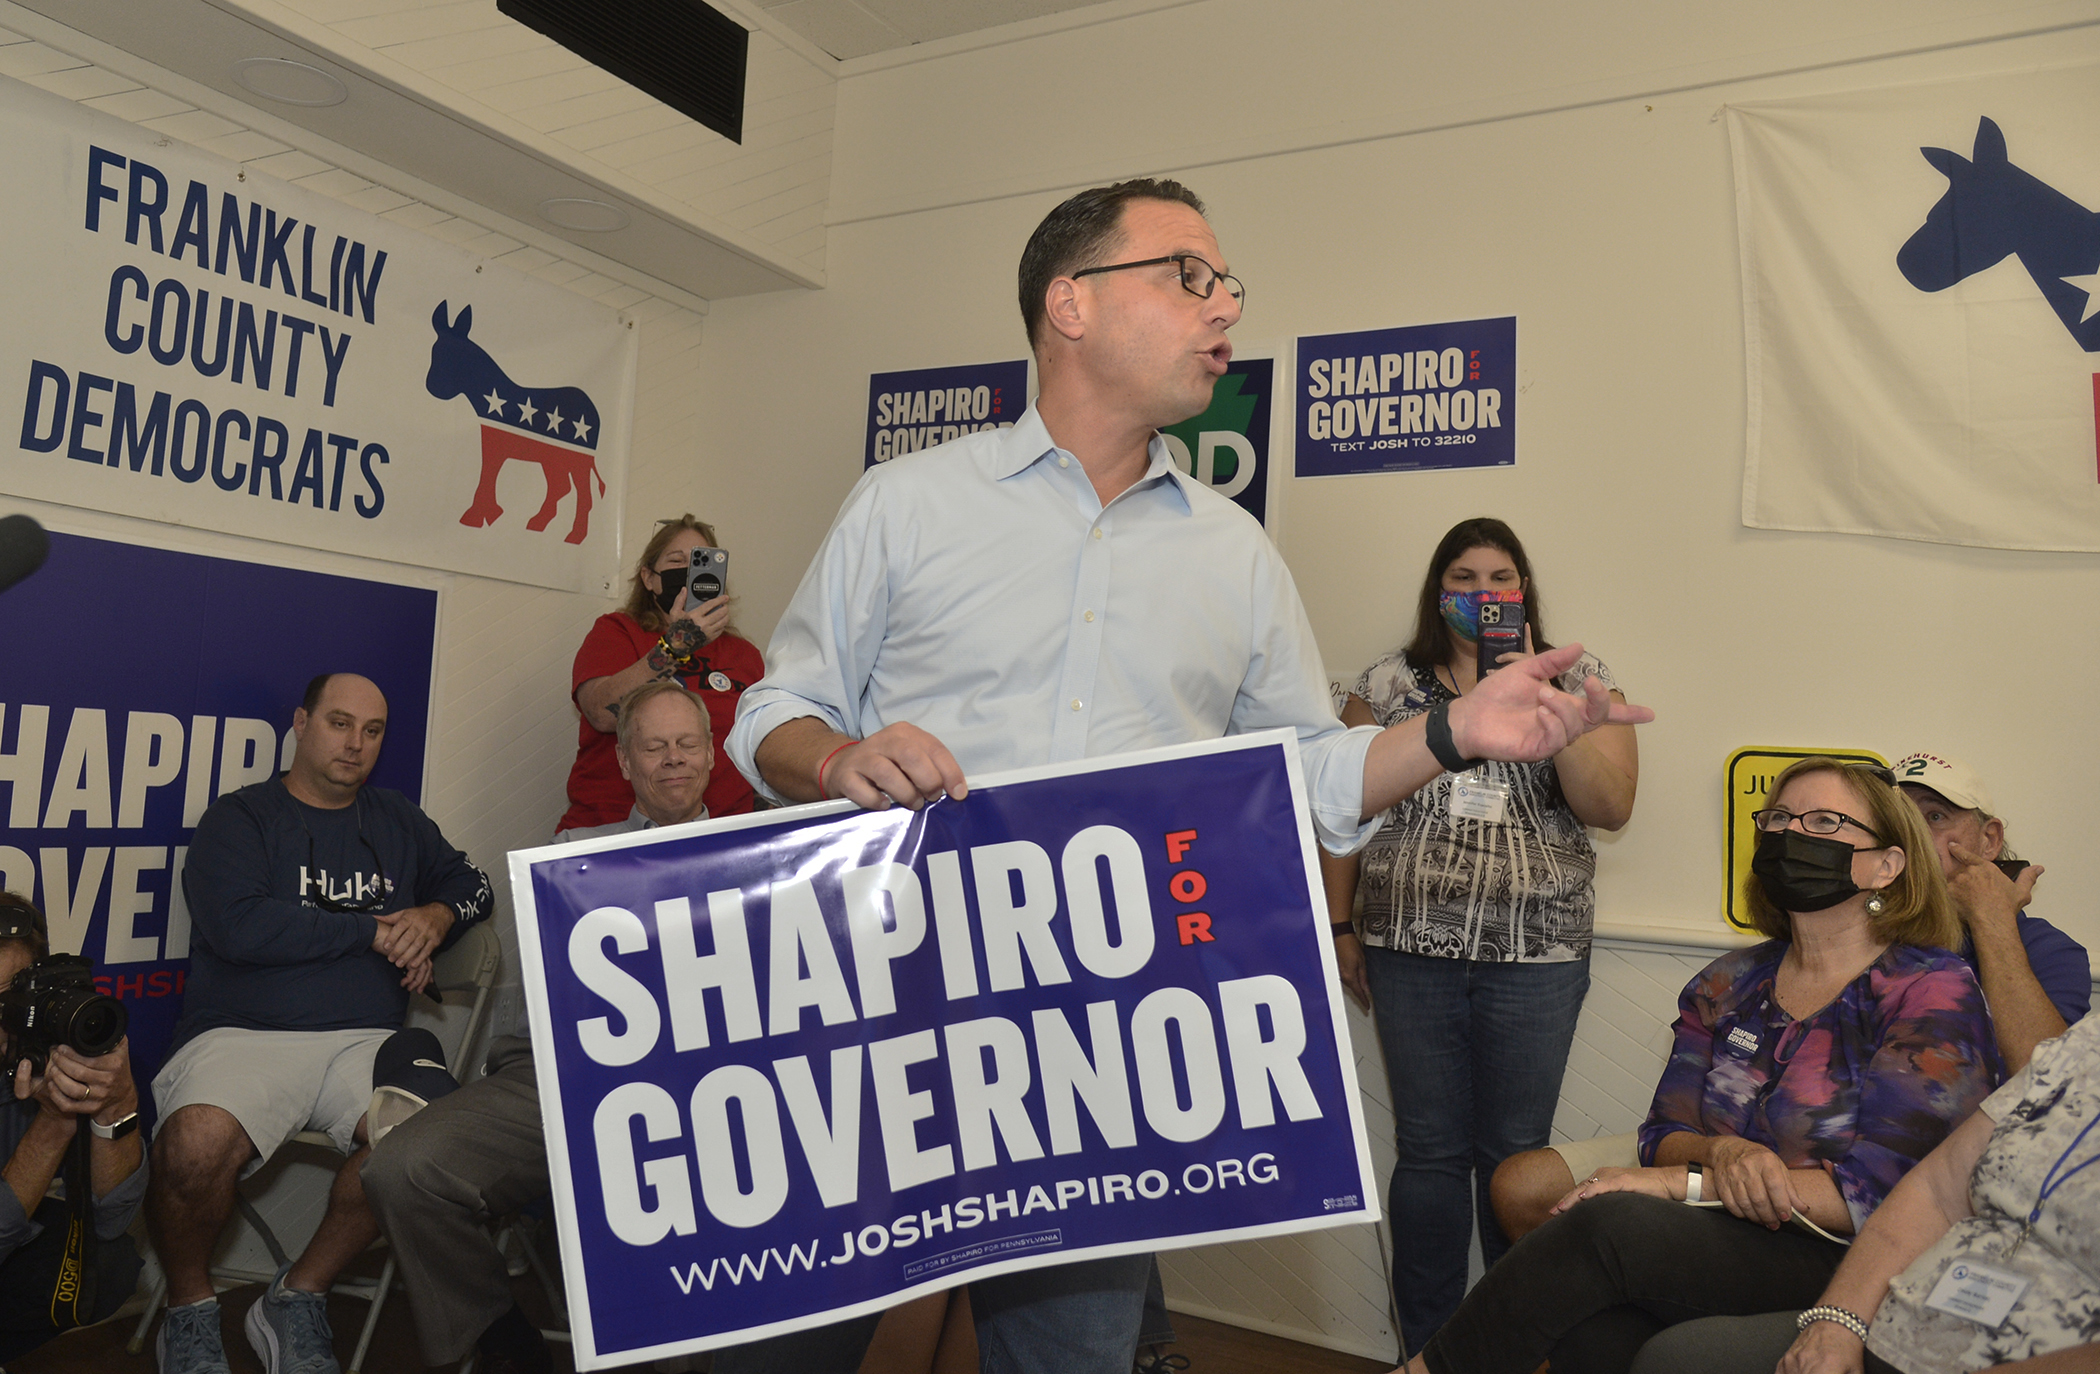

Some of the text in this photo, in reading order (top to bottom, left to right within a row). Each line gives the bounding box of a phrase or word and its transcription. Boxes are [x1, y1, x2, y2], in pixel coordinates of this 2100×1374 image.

[85, 144, 388, 325] FRANKLIN
[104, 264, 352, 408] COUNTY
[1308, 347, 1464, 398] SHAPIRO
[1469, 350, 1480, 380] FOR
[876, 385, 990, 426] SHAPIRO
[993, 388, 1002, 414] FOR
[1308, 388, 1501, 441] GOVERNOR
[19, 359, 390, 519] DEMOCRATS
[874, 421, 1016, 463] GOVE
[1331, 434, 1476, 452] TEXT JOSH TO 32210
[1905, 759, 1927, 776] 2
[1164, 828, 1217, 947] FOR
[568, 825, 1155, 1067] SHAPIRO
[27, 1005, 35, 1028] Nikon
[593, 974, 1324, 1246] GOVERNOR
[670, 1152, 1280, 1295] WWW.JOSHSHAPIRO.ORG
[907, 1233, 1059, 1275] PAID FOR BY SHAPIRO FOR PENNSYLVANIA
[58, 1258, 79, 1302] D500
